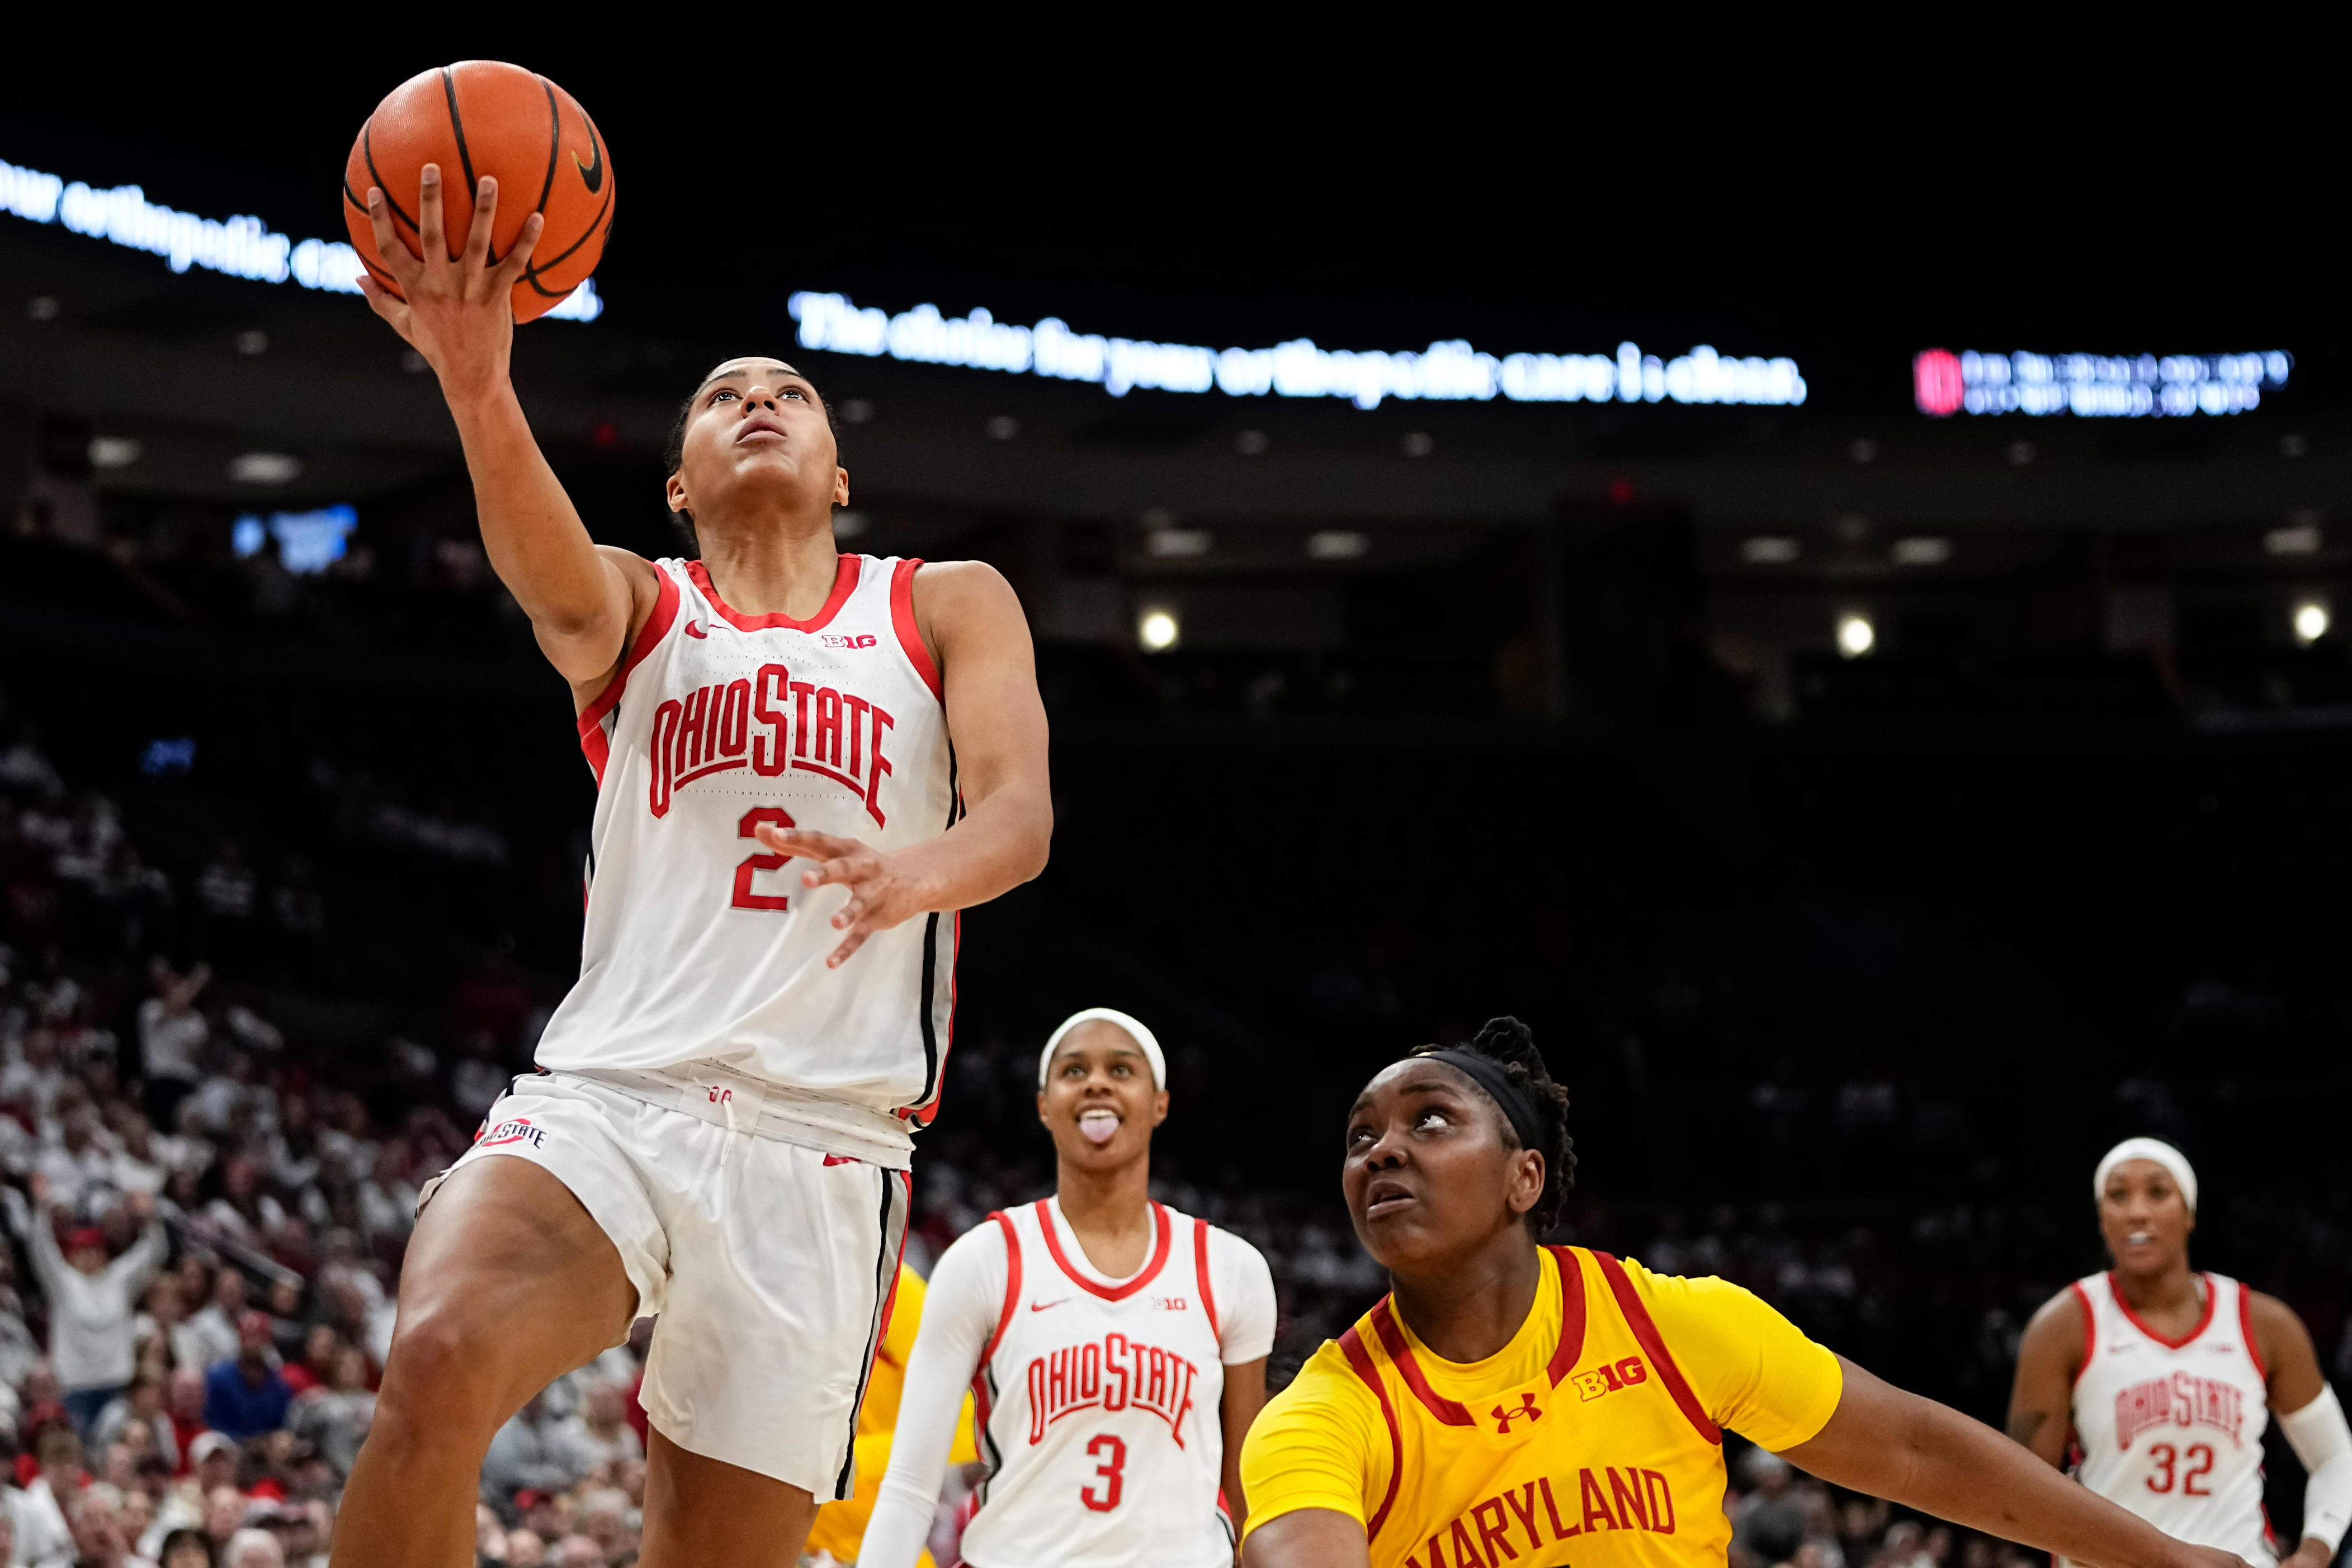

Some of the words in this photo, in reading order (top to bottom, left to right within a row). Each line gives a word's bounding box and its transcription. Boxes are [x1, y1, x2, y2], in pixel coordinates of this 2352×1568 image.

[730, 805, 797, 913] 2
[1081, 1433, 1126, 1513] 3
[2146, 1442, 2214, 1496] 32
